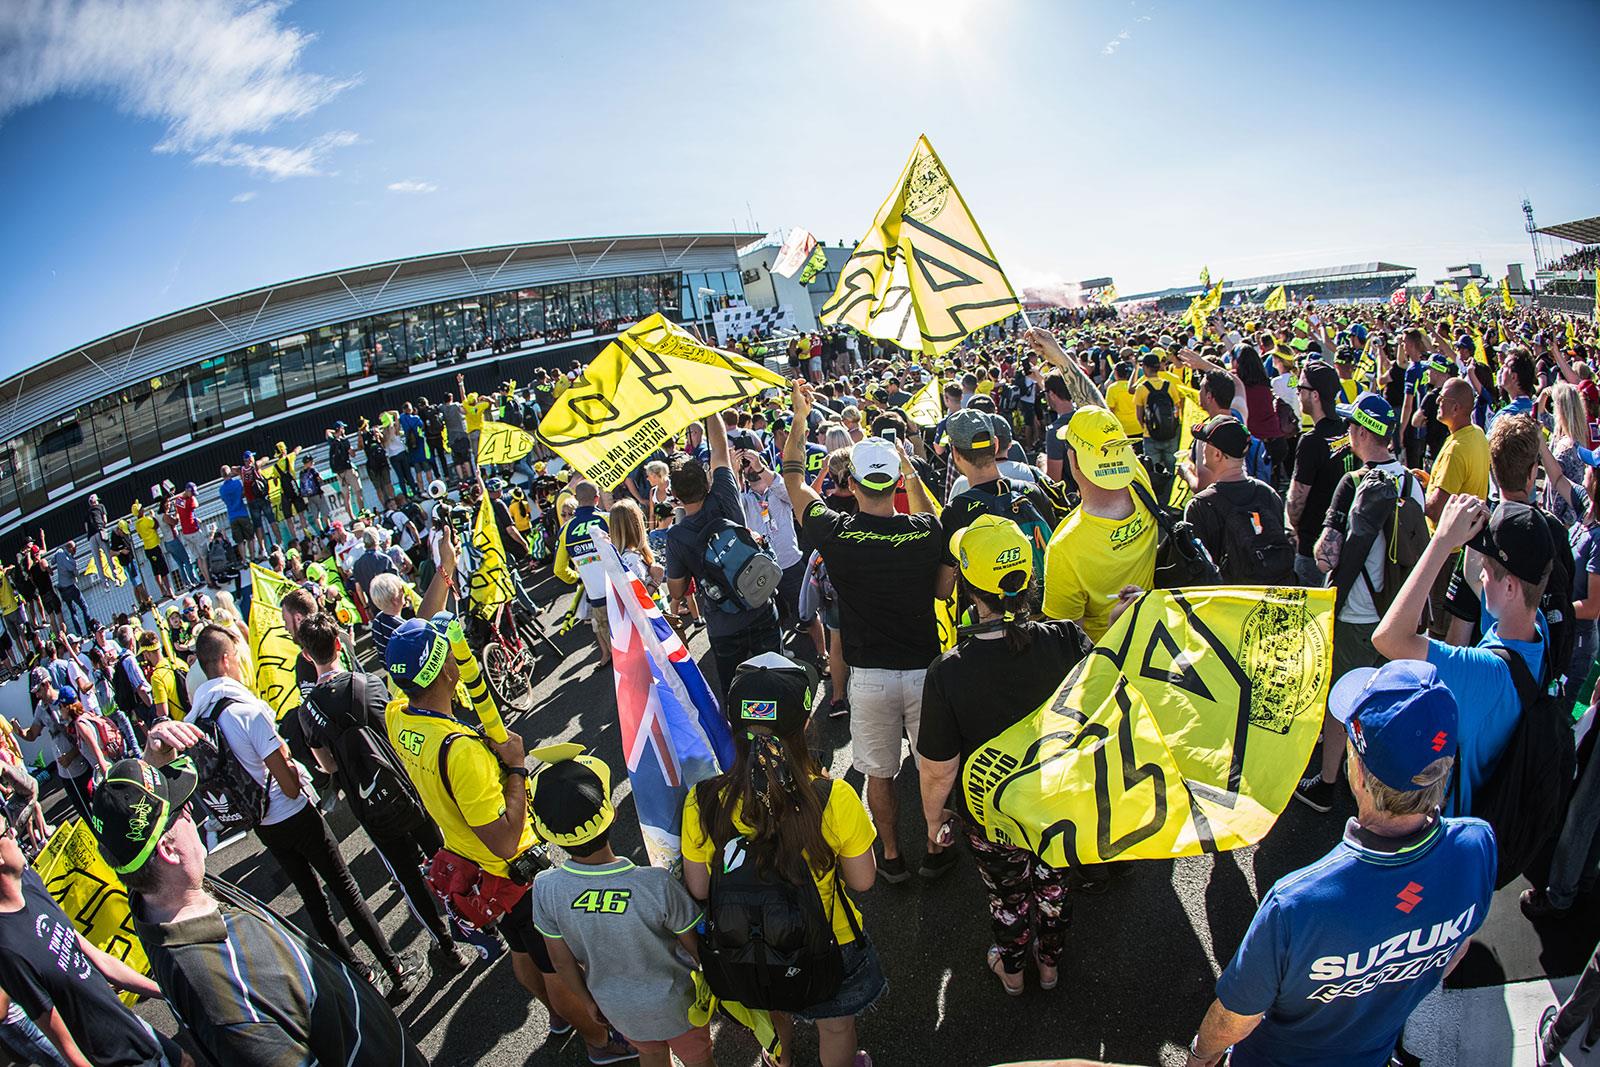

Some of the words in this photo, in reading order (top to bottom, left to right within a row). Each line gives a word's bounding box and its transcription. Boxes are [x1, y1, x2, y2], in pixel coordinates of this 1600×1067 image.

[537, 384, 552, 393] 46
[1362, 416, 1383, 432] YAMAHA
[1109, 517, 1142, 542] 46
[996, 546, 1020, 564] 46
[389, 663, 406, 674] 46
[426, 641, 444, 673] YAMAHA
[398, 728, 426, 757] 46
[367, 786, 388, 807] AIR
[218, 812, 243, 822] adidas
[570, 888, 632, 915] 46
[47, 921, 66, 955] TOMMY
[1308, 903, 1477, 981] SUZUKI
